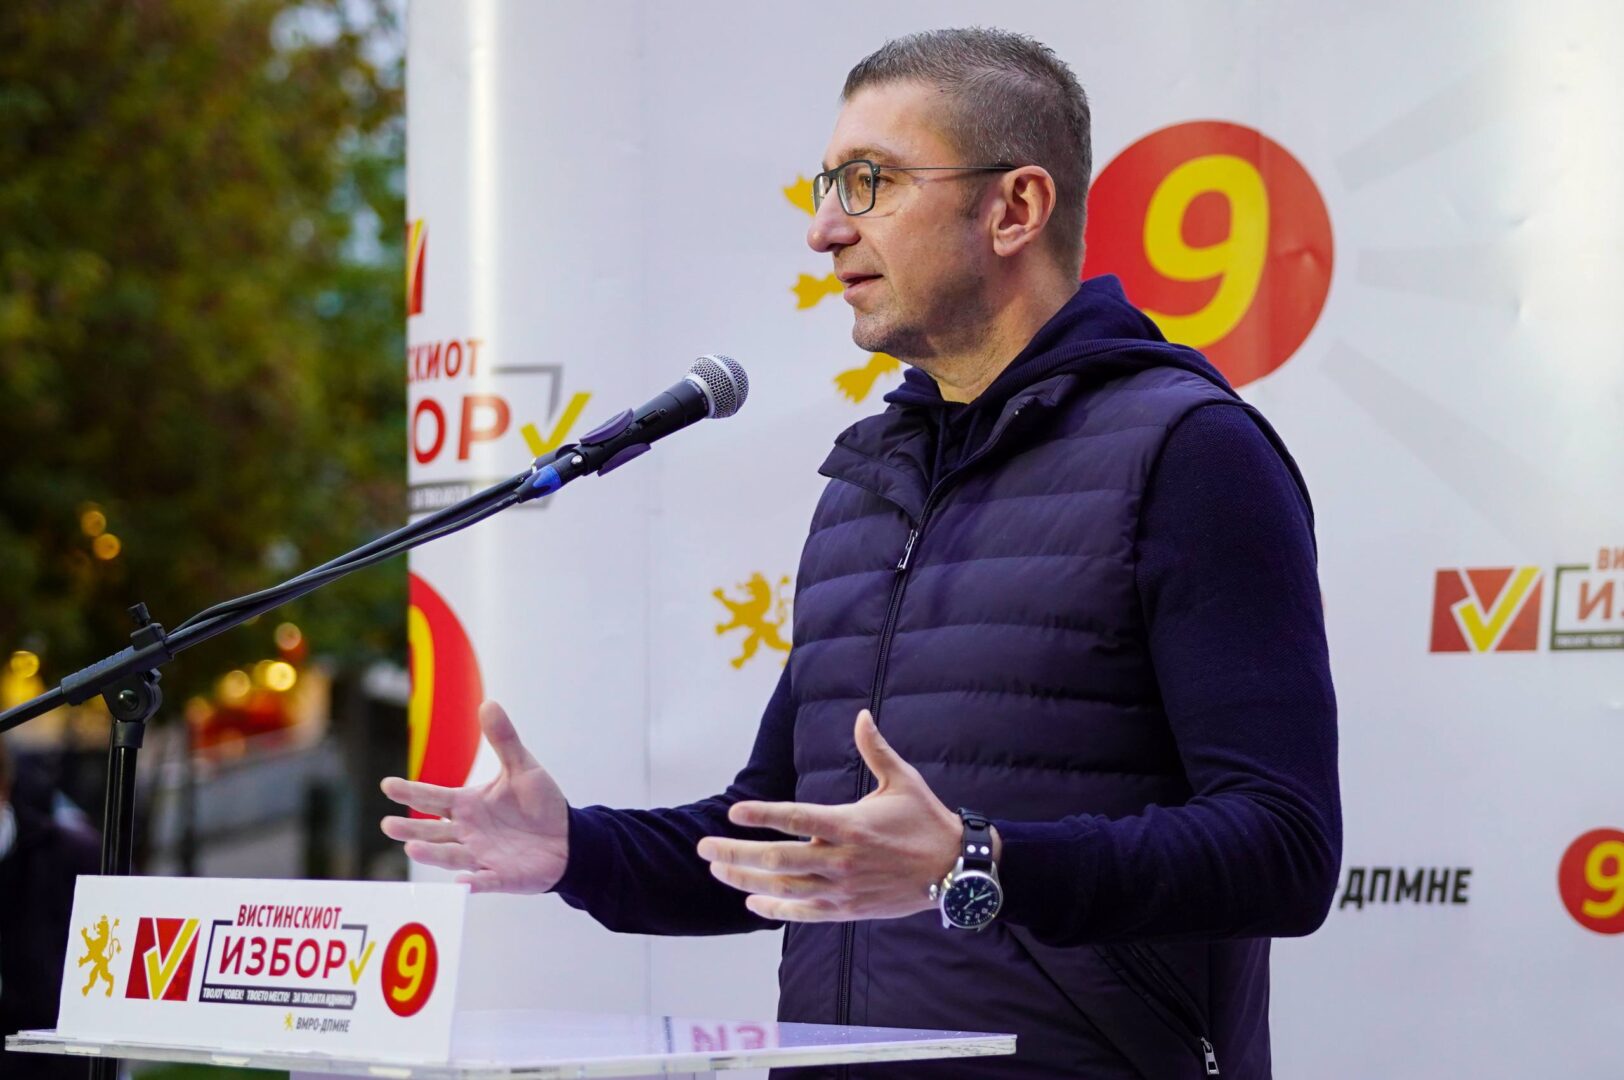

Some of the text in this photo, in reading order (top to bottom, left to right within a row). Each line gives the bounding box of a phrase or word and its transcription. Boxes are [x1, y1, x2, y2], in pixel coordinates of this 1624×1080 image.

[1143, 154, 1270, 349] 9
[1578, 580, 1624, 621] И
[1339, 866, 1472, 910] ДПМНЕ
[1583, 840, 1624, 919] 9
[237, 904, 342, 930] ВИСТИНСКИОТ
[219, 935, 348, 980] ИЗБОР
[390, 933, 428, 1003] 9
[296, 1016, 351, 1033] ВМРО-ДПМНЕ
